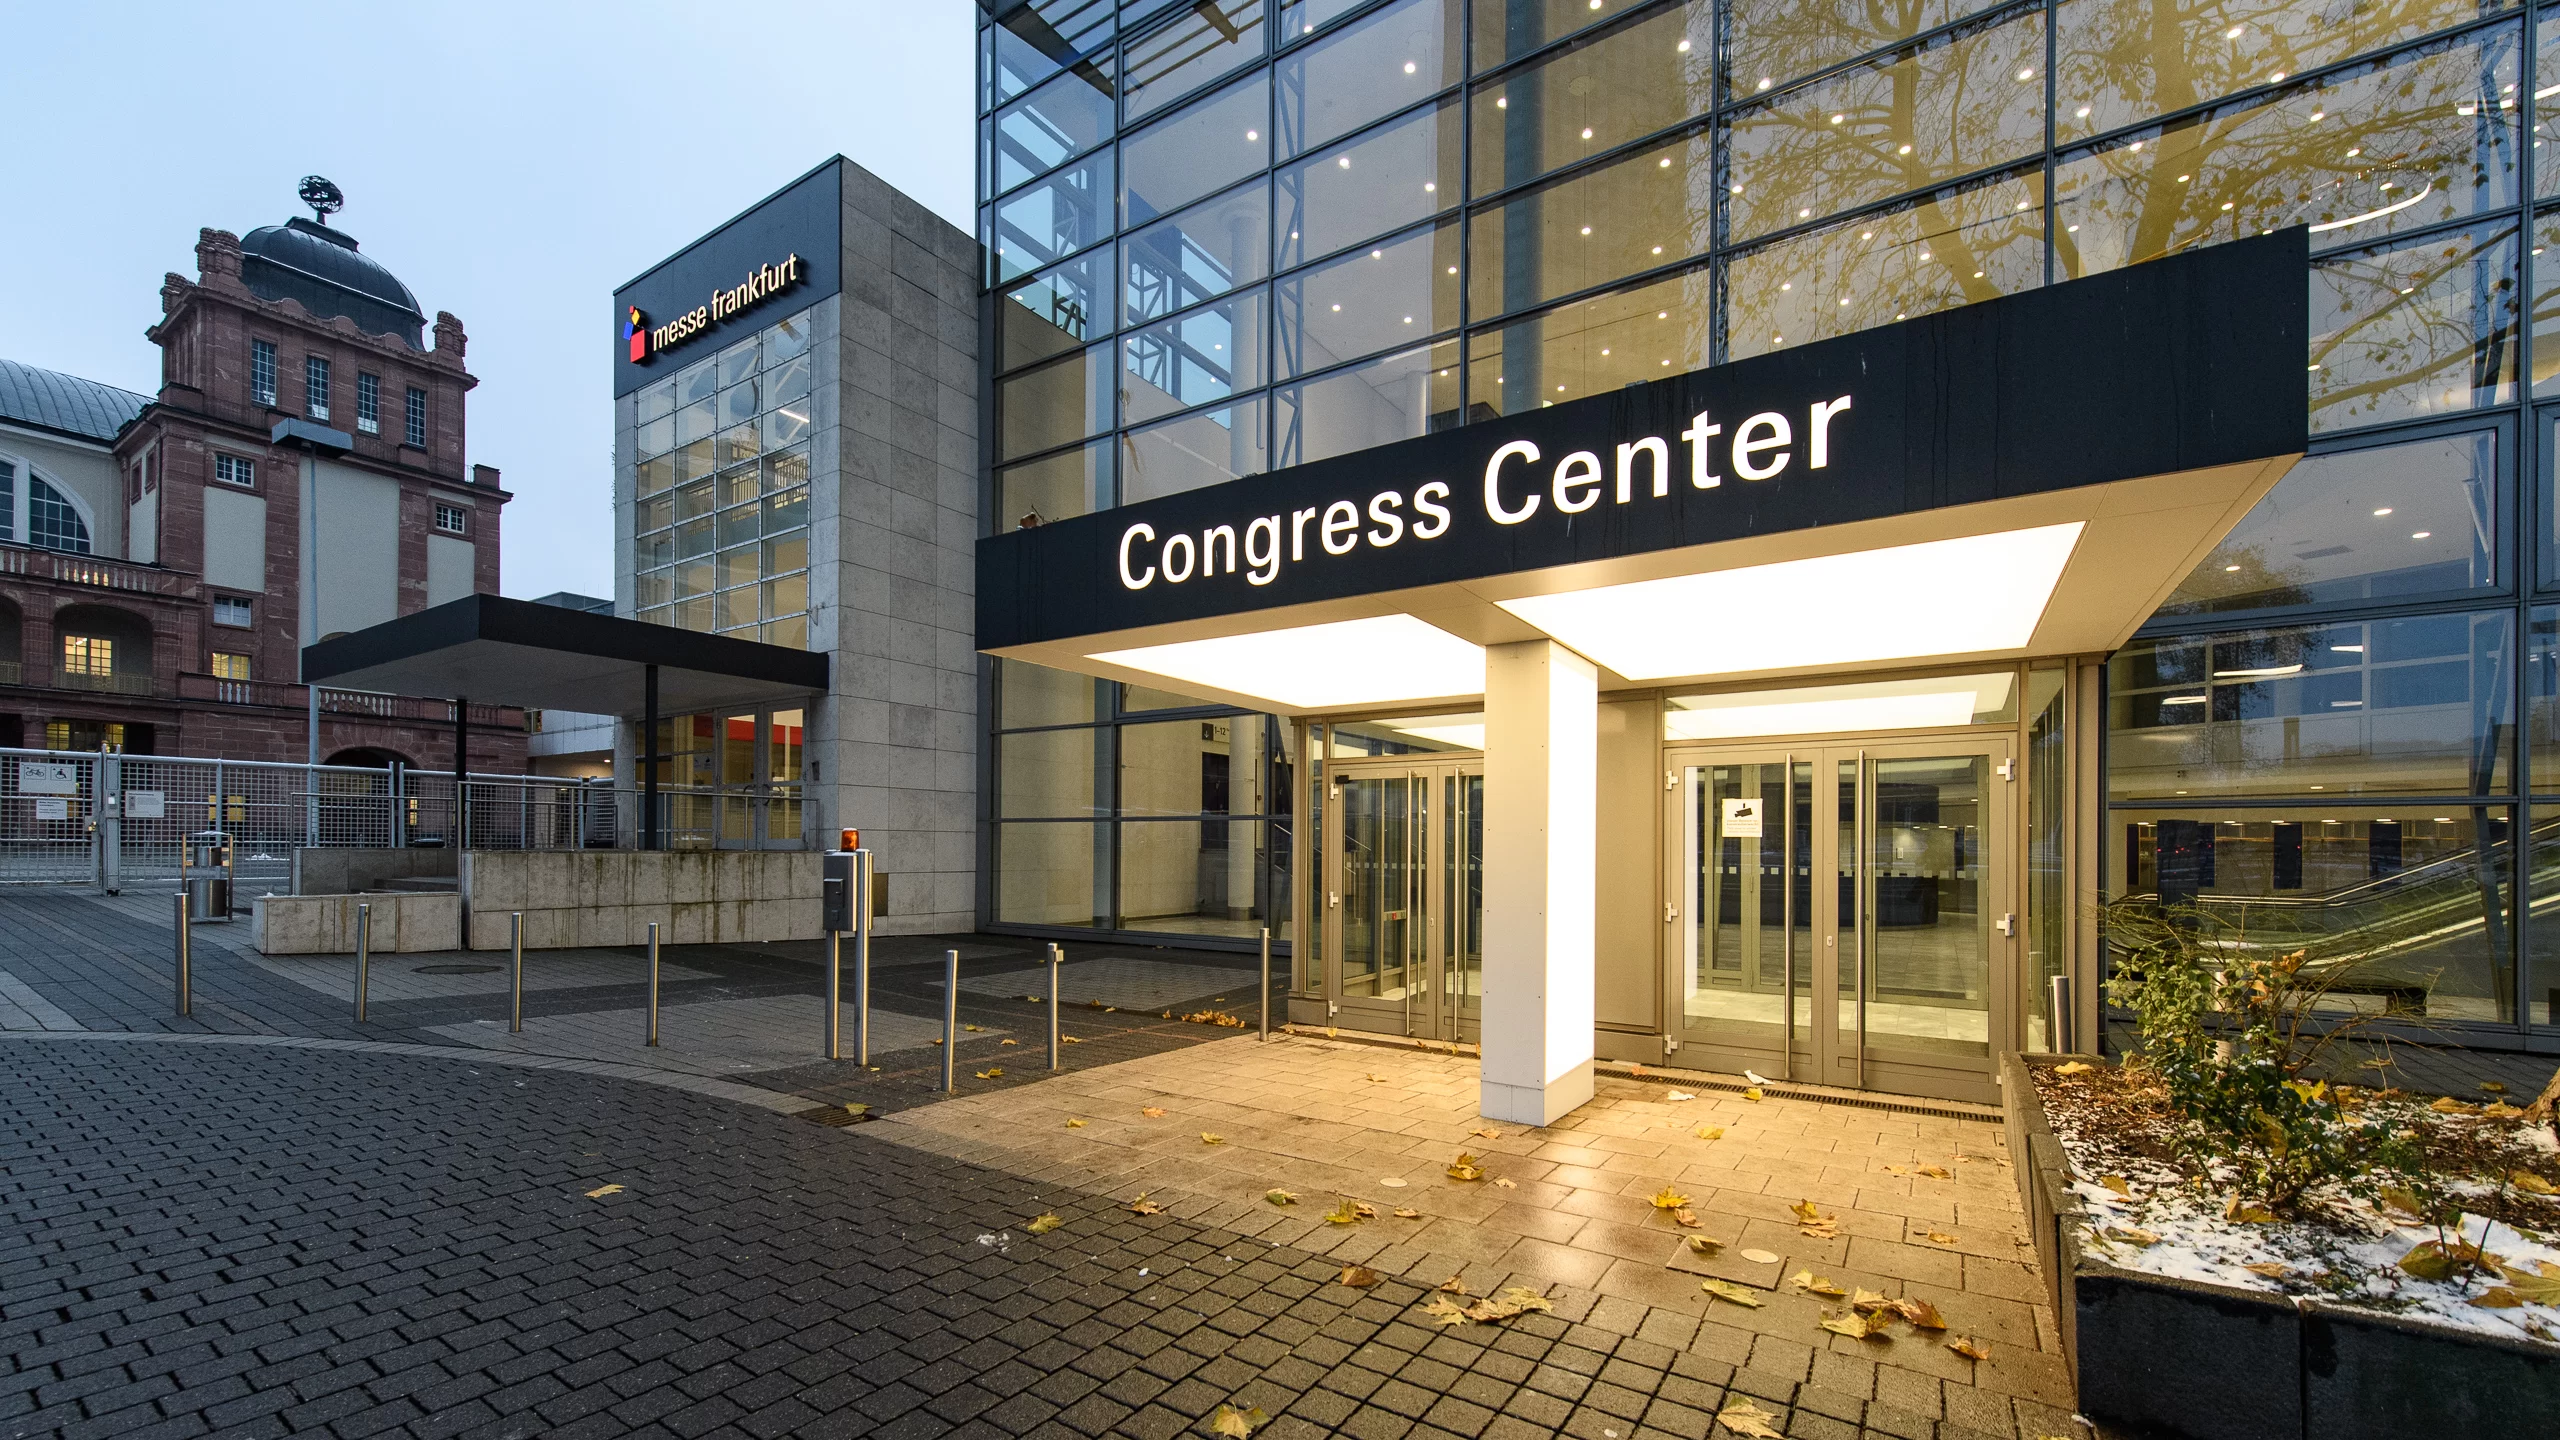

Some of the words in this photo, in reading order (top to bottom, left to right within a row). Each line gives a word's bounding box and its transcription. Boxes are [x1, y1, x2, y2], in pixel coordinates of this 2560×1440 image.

[653, 305, 707, 351] messe
[711, 252, 797, 321] frankfurt
[1118, 480, 1452, 590] Congress
[1483, 394, 1852, 525] Center
